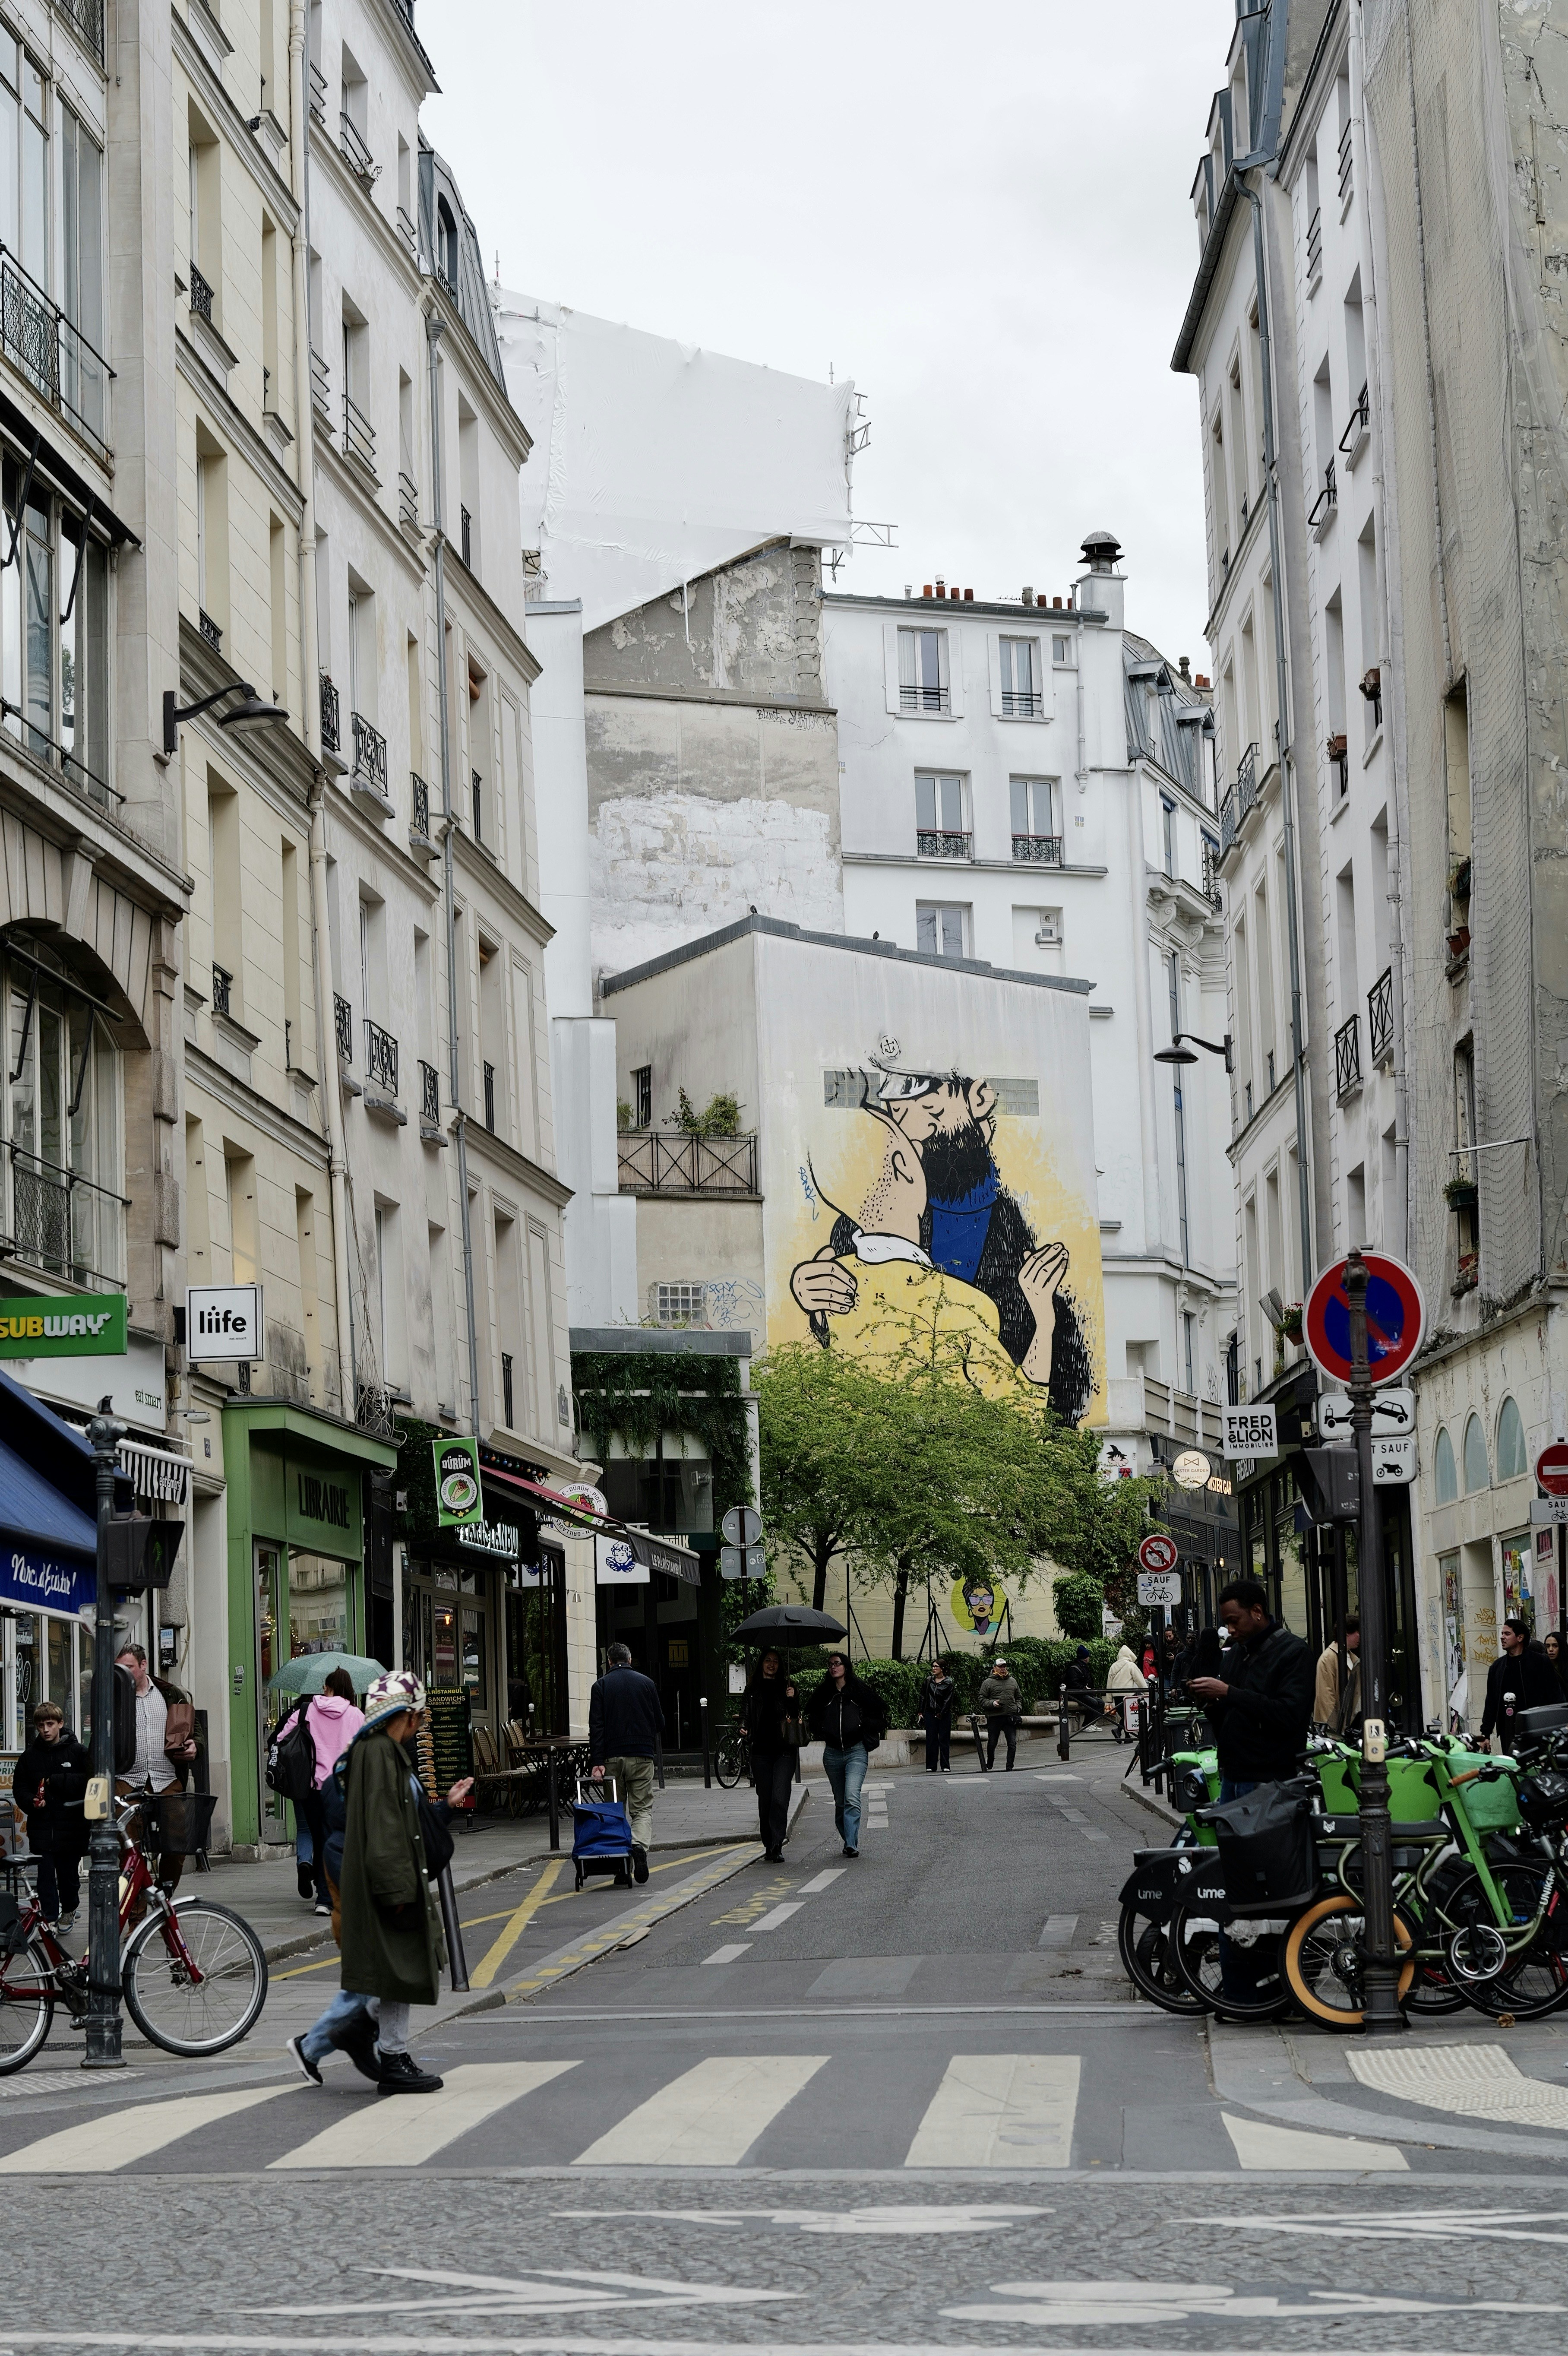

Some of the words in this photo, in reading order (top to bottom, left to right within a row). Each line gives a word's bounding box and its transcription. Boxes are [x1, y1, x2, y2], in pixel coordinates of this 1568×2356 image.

[0, 1312, 113, 1338] SUBWAY
[199, 1306, 247, 1333] liife
[135, 1389, 143, 1403] eat
[144, 1393, 161, 1410] smart
[1227, 1415, 1271, 1429] FRED
[1381, 1443, 1408, 1454] SAUF
[442, 1454, 471, 1470] DÜRÜM
[167, 1478, 180, 1491] smart
[1208, 1476, 1223, 1494] MISTER
[1223, 1480, 1232, 1495] GAR
[297, 1473, 350, 1529] LIBRAIRIE
[555, 1519, 581, 1536] GRILLADES
[651, 1553, 657, 1567] LE
[1138, 1889, 1162, 1899] Lime
[1197, 1887, 1226, 1899] Lime
